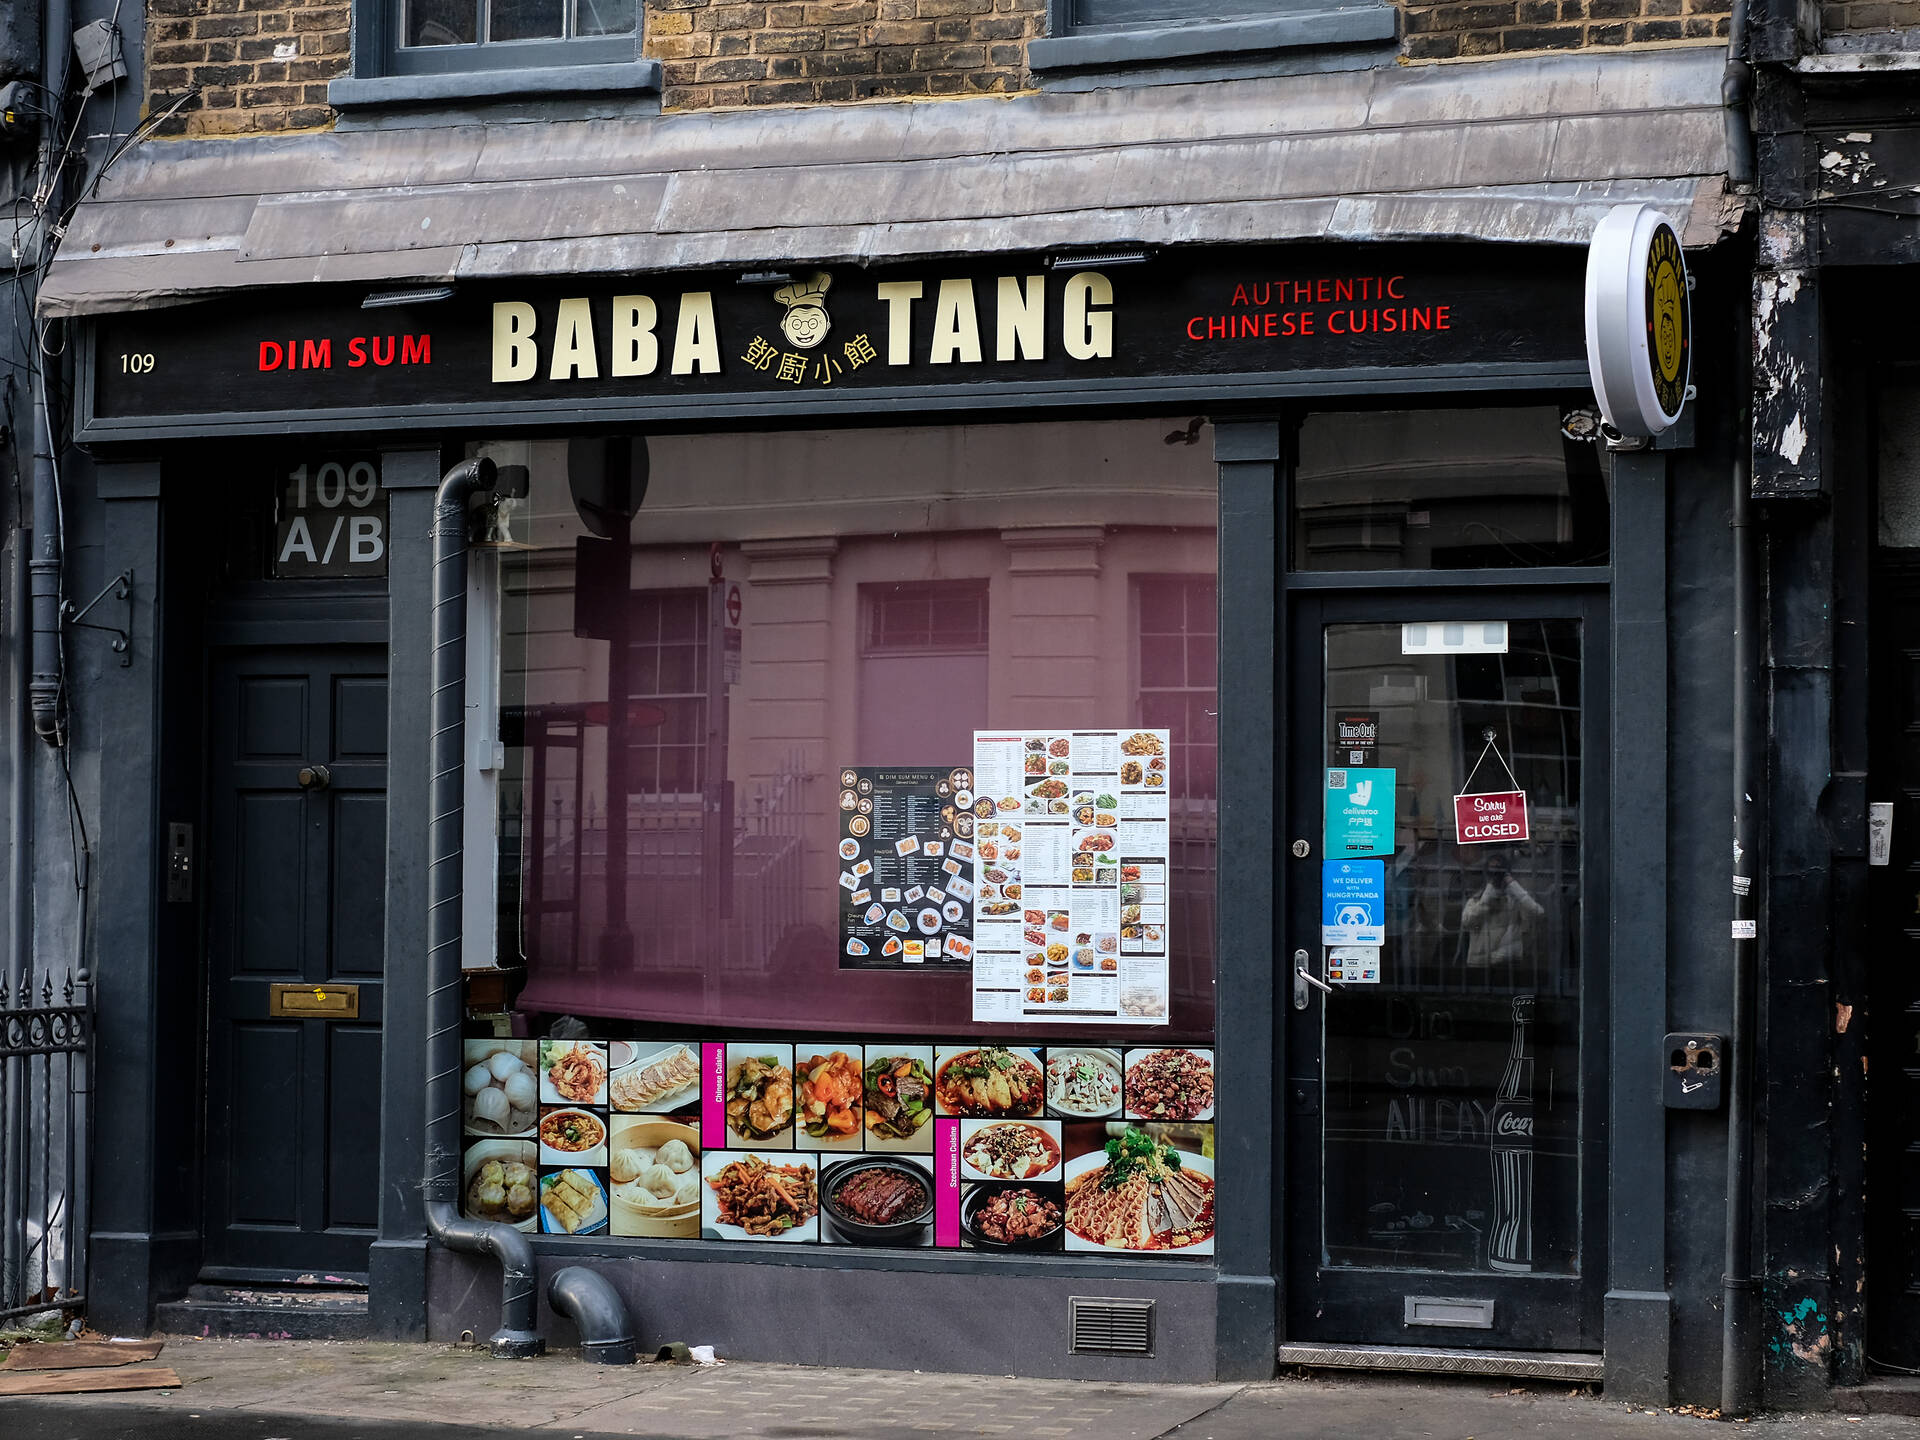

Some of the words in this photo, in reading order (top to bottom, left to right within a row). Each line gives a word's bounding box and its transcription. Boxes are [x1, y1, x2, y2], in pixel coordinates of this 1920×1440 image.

[1647, 233, 1666, 288] BABA
[1667, 233, 1686, 299] TANG
[1231, 275, 1405, 306] AUTHENTIC
[491, 291, 721, 383] BABA
[877, 271, 1115, 366] TANG
[1186, 311, 1315, 340] CHINESE
[1327, 305, 1451, 334] CUISINE
[120, 353, 155, 374] 109
[258, 338, 332, 371] DIM
[348, 334, 431, 367] SUM
[740, 333, 878, 385] 鄧廚小館
[289, 461, 377, 508] 109
[279, 516, 384, 565] A/B
[1338, 722, 1360, 737] Time
[1360, 722, 1376, 737] Out
[1342, 807, 1379, 815] deliveroo
[1473, 797, 1506, 814] Sorry
[1490, 814, 1504, 822] are
[1464, 823, 1520, 838] CLOSED
[715, 1048, 723, 1074] Cuisine
[715, 1075, 723, 1103] Chinese
[949, 1126, 957, 1153] Cuisine
[949, 1153, 957, 1188] Szechuan
